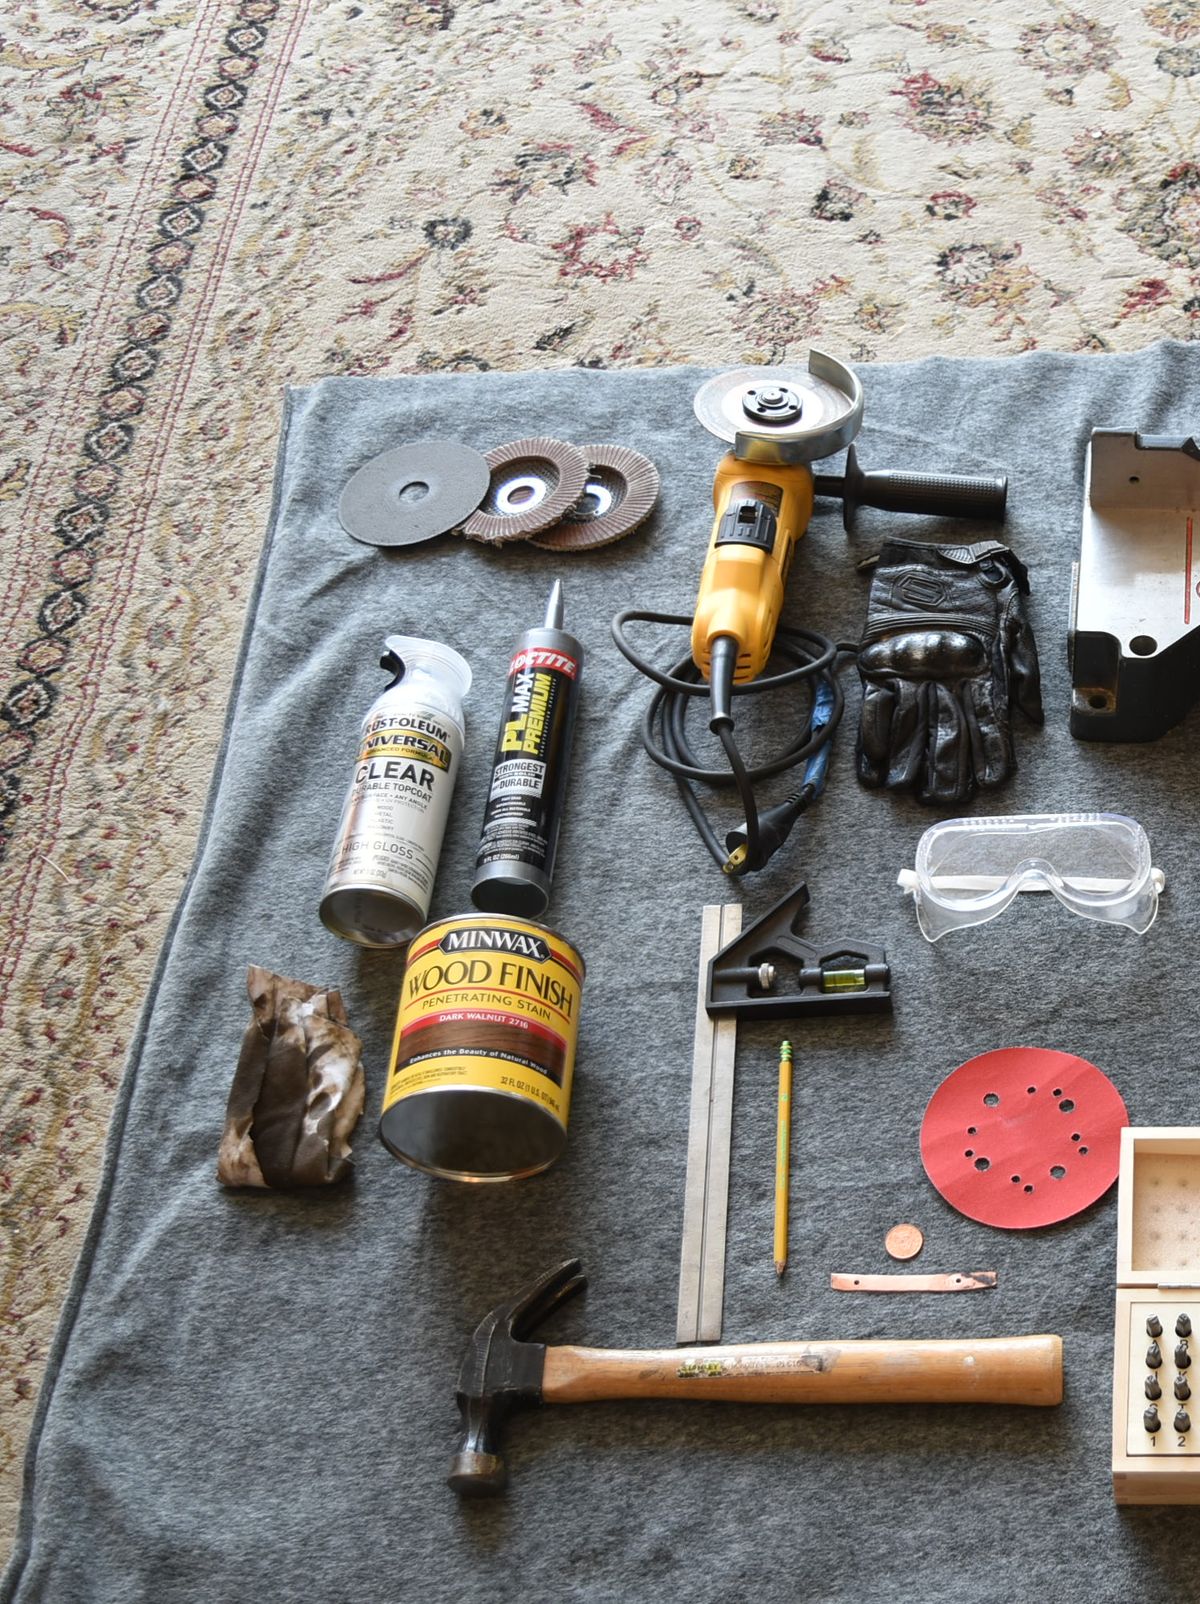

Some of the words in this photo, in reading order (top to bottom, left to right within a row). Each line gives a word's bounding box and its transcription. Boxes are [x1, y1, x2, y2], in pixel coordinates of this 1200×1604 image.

[511, 672, 535, 712] MAX
[522, 672, 552, 754] PREMIUM
[501, 713, 528, 752] PL
[364, 734, 449, 766] NIVERSAL
[356, 760, 435, 792] CLEAR
[495, 762, 544, 777] STRONGEST
[500, 778, 542, 790] DURABLE
[393, 782, 433, 803] TOPCOAT
[373, 841, 414, 860] GLOSS
[448, 930, 544, 959] MINWAX
[408, 959, 492, 1000] WOOD
[499, 962, 574, 1018] FINISH
[422, 992, 512, 1010] PENETRATING
[518, 1000, 551, 1021] STAIN
[440, 1012, 464, 1022] DARK
[466, 1013, 506, 1023] WALNUT
[409, 1052, 441, 1064] Enhances
[444, 1048, 457, 1056] the
[460, 1048, 488, 1056] Beauty
[500, 1052, 528, 1064] Natural
[530, 1062, 548, 1074] Wood
[1150, 1436, 1156, 1446] 1
[1178, 1436, 1186, 1447] 2
